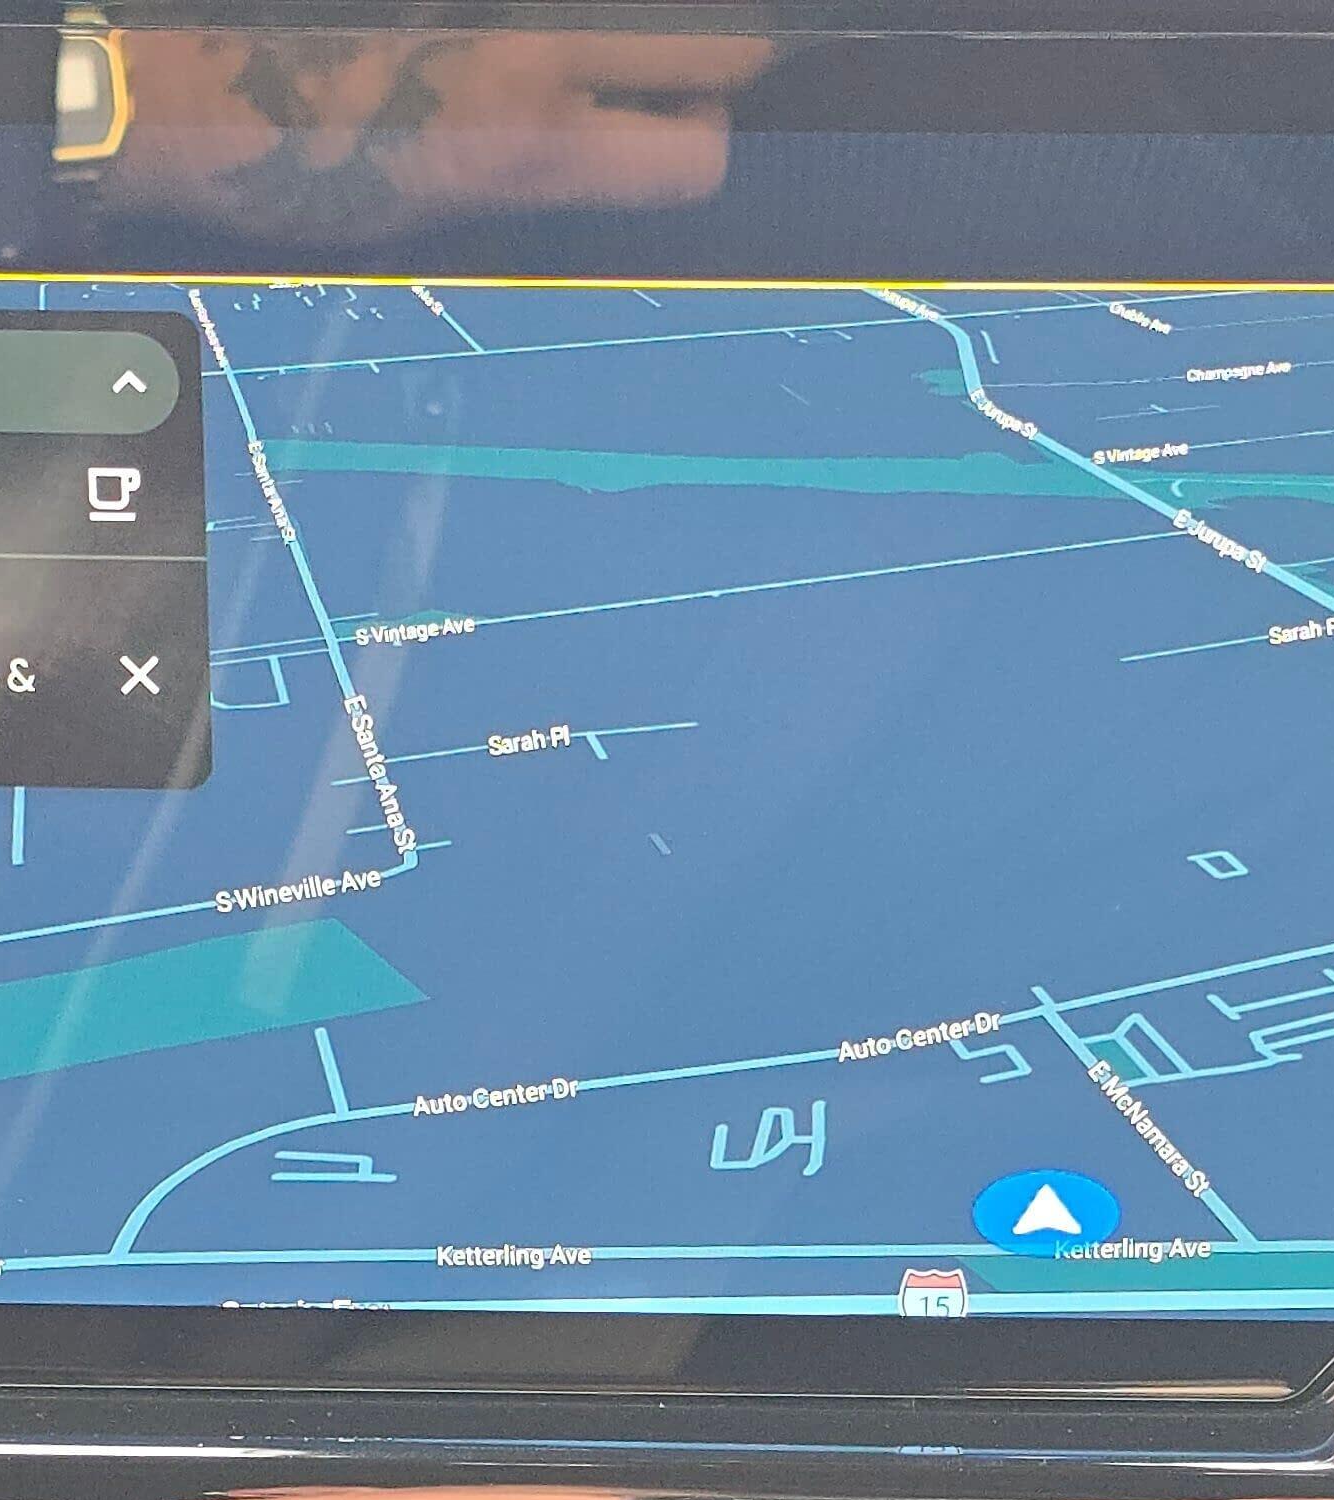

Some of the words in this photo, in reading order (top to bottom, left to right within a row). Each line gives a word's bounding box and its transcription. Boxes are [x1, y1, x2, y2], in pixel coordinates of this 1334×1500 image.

[1186, 363, 1265, 382] Champagne
[1265, 360, 1293, 375] Ave
[1091, 450, 1106, 466] S
[1105, 446, 1161, 464] Vintage
[1161, 442, 1189, 458] Ave
[1173, 507, 1193, 529] E
[1186, 519, 1246, 562] Jurupa
[1244, 549, 1267, 574] St
[356, 628, 369, 646] S
[370, 623, 440, 644] Vintage
[443, 617, 476, 637] Ave
[1268, 619, 1324, 646] Sarah
[6, 657, 37, 694] &
[344, 694, 367, 715] E
[350, 713, 386, 781] Santa
[487, 729, 548, 757] Sarah
[549, 724, 570, 749] Pl
[374, 783, 405, 829] Ana
[393, 827, 417, 855] St
[214, 890, 233, 913] S
[233, 875, 337, 911] Wineville
[340, 869, 381, 893] Ave
[837, 1036, 892, 1063] Auto
[895, 1018, 972, 1051] Center
[974, 1011, 1001, 1034] Dr
[412, 1093, 468, 1117] Auto
[472, 1083, 548, 1109] Center
[551, 1077, 579, 1100] Dr
[1087, 1059, 1111, 1084] E
[1100, 1075, 1189, 1177] McNamara
[1184, 1169, 1210, 1198] St
[436, 1243, 545, 1270] Ketterling
[549, 1242, 592, 1266] Ave
[1053, 1237, 1163, 1264] Ketterling
[1168, 1237, 1212, 1260] Ave
[919, 1295, 950, 1317] 15
